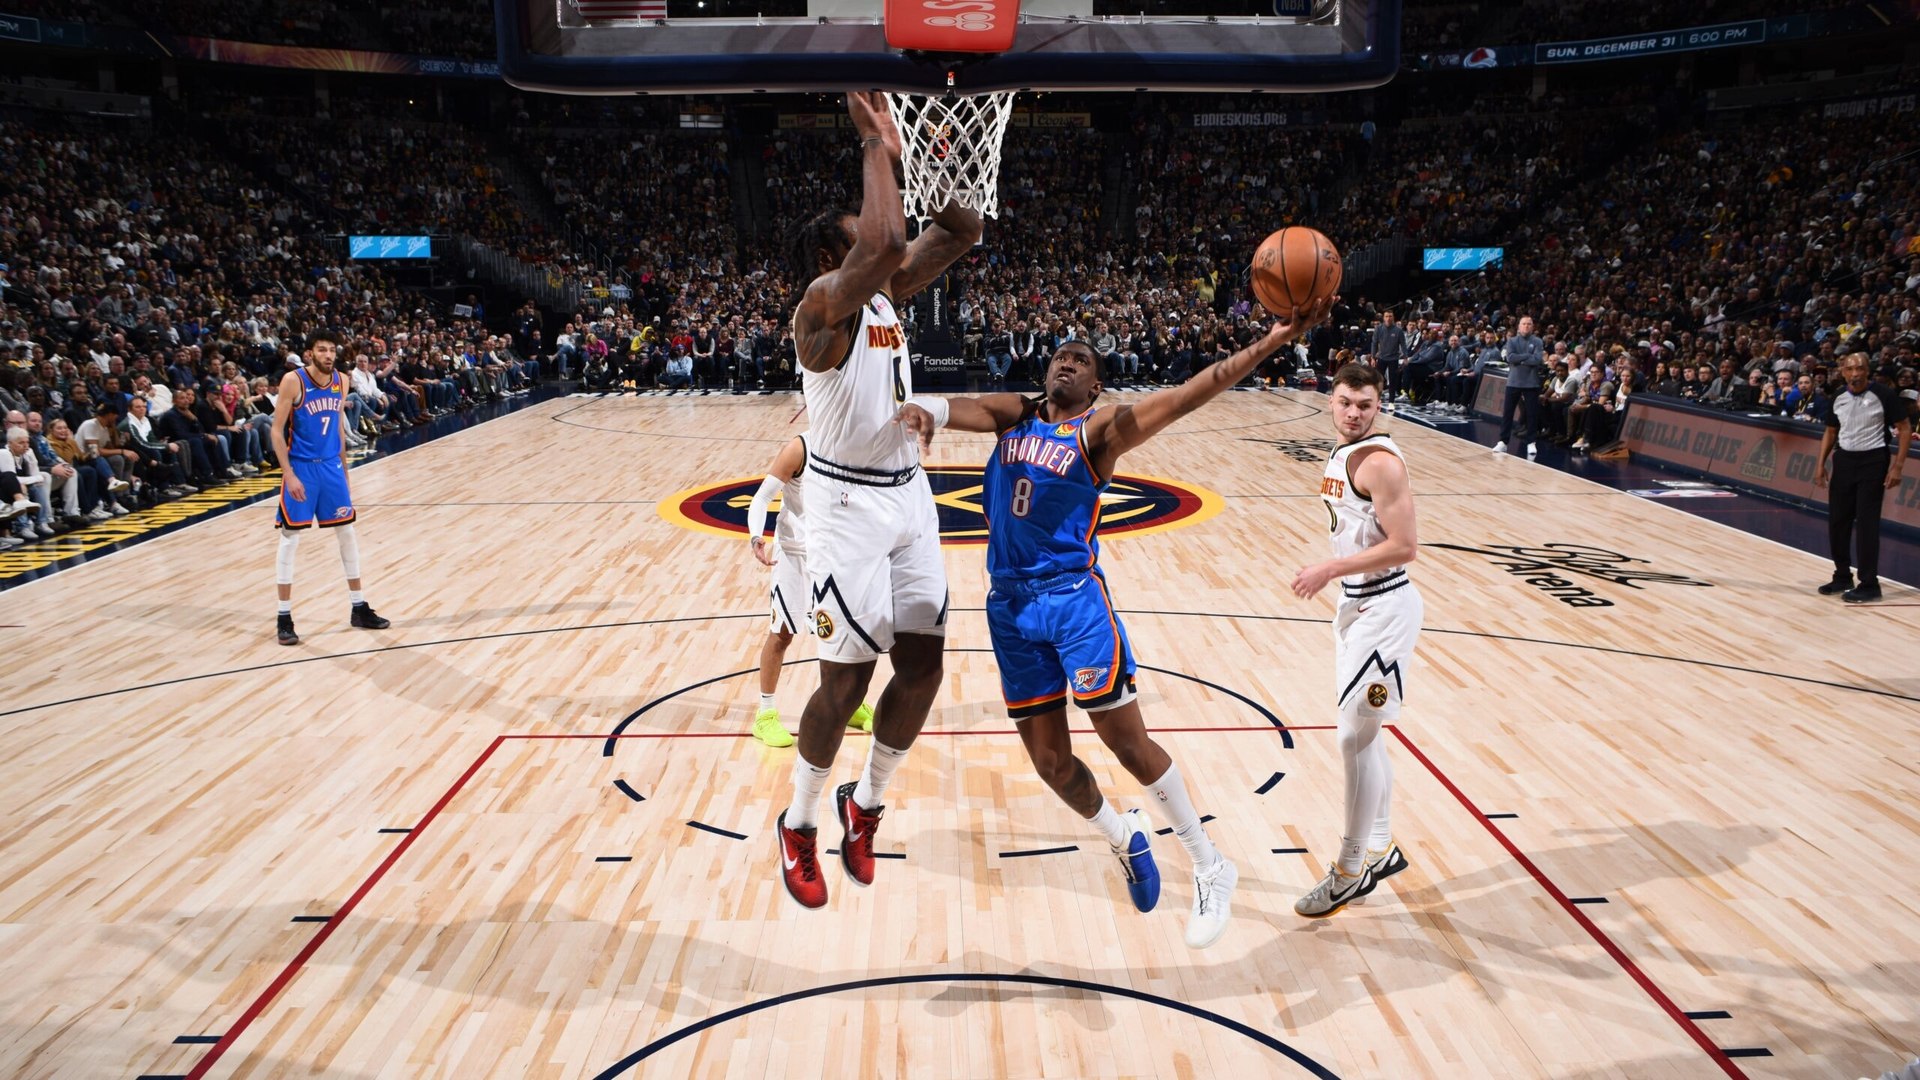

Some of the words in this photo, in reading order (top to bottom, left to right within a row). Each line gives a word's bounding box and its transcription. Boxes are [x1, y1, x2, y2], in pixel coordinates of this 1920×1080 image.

[1546, 47, 1579, 58] SUN.
[1584, 38, 1656, 56] DECEMBER
[1661, 36, 1676, 47] 31
[1689, 31, 1720, 45] 6:00
[1724, 27, 1748, 39] PM
[419, 60, 456, 72] NEW
[1193, 112, 1288, 127] EDDIESKIDS.ORG
[933, 287, 941, 326] Southwest
[923, 356, 964, 366] Fanatics
[320, 416, 331, 436] 7
[1625, 416, 1691, 453] GORILLA
[1691, 431, 1743, 465] GLUE
[1000, 435, 1077, 478] THUNDER
[1011, 476, 1033, 518] 8
[1420, 543, 1715, 589] Ball
[1490, 561, 1615, 608] Arena
[1078, 671, 1095, 685] OKC
